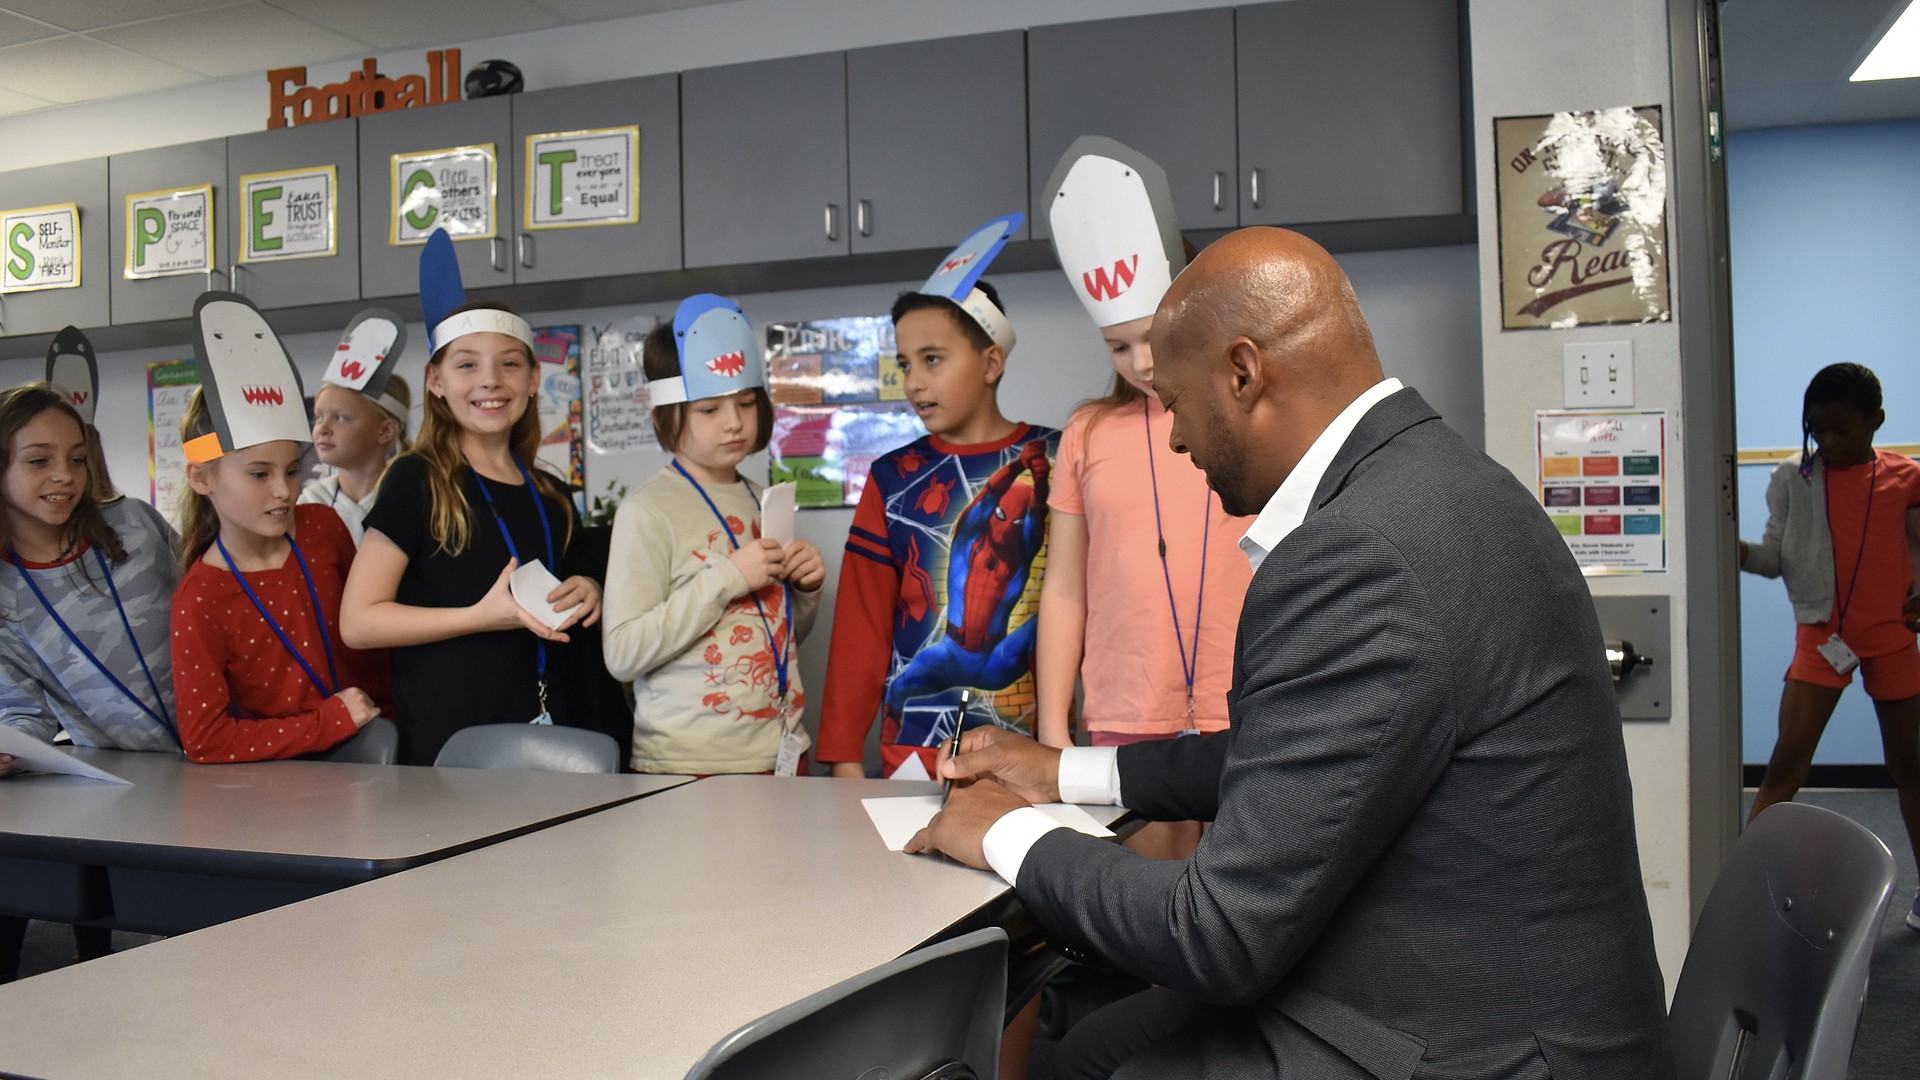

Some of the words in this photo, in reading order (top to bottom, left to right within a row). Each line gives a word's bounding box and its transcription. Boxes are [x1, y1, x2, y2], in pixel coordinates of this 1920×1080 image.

[267, 47, 461, 130] Football
[581, 152, 619, 169] Treat
[403, 168, 438, 230] C
[441, 186, 480, 199] others
[539, 149, 577, 216] T
[581, 189, 619, 207] Equal
[39, 221, 63, 236] SELF-
[170, 219, 200, 232] SPACE
[252, 185, 283, 252] E
[286, 201, 325, 222] TRUST
[7, 222, 35, 280] S
[136, 207, 166, 267] P
